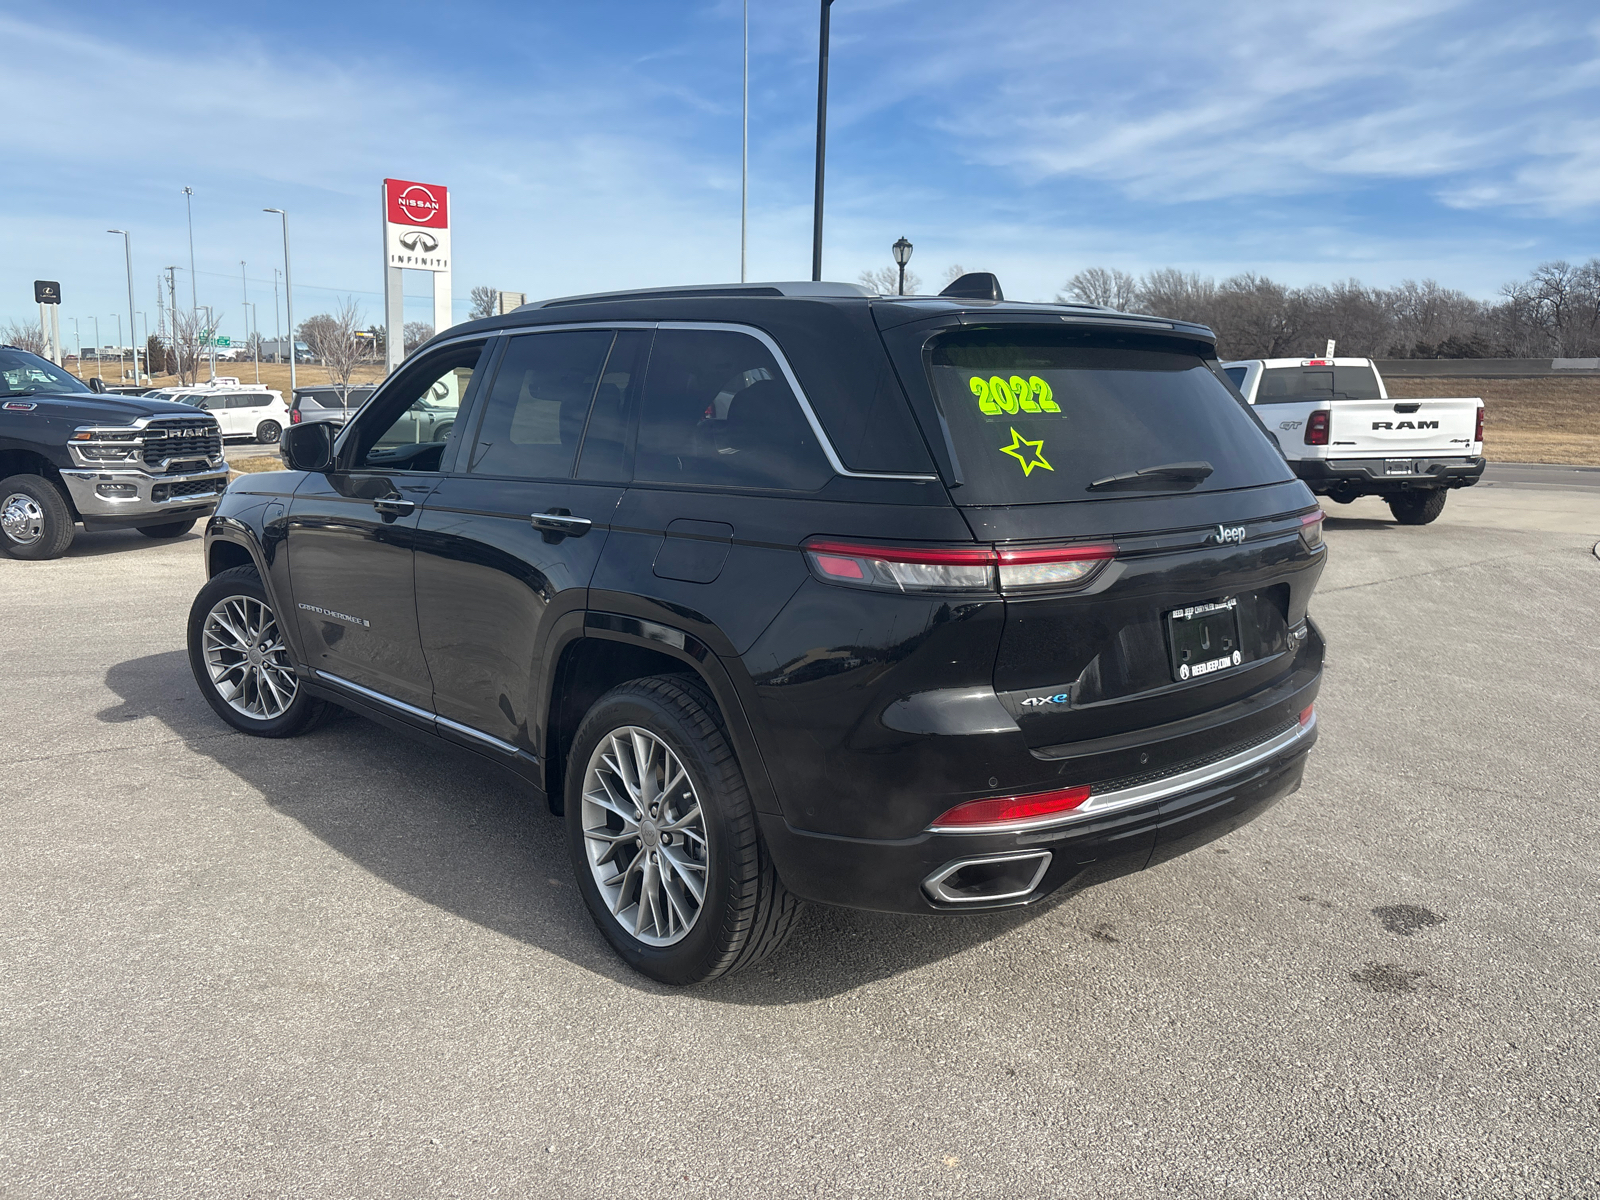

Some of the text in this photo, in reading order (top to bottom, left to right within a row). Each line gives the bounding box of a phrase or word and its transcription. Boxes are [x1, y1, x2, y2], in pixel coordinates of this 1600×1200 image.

[398, 198, 439, 210] NISSAN
[391, 254, 448, 267] INFINITI
[969, 375, 1062, 416] 2022
[1371, 420, 1440, 430] RAM
[169, 426, 209, 438] RAM
[1215, 524, 1246, 544] Jeep
[298, 603, 362, 625] GRAND CHEROKEE
